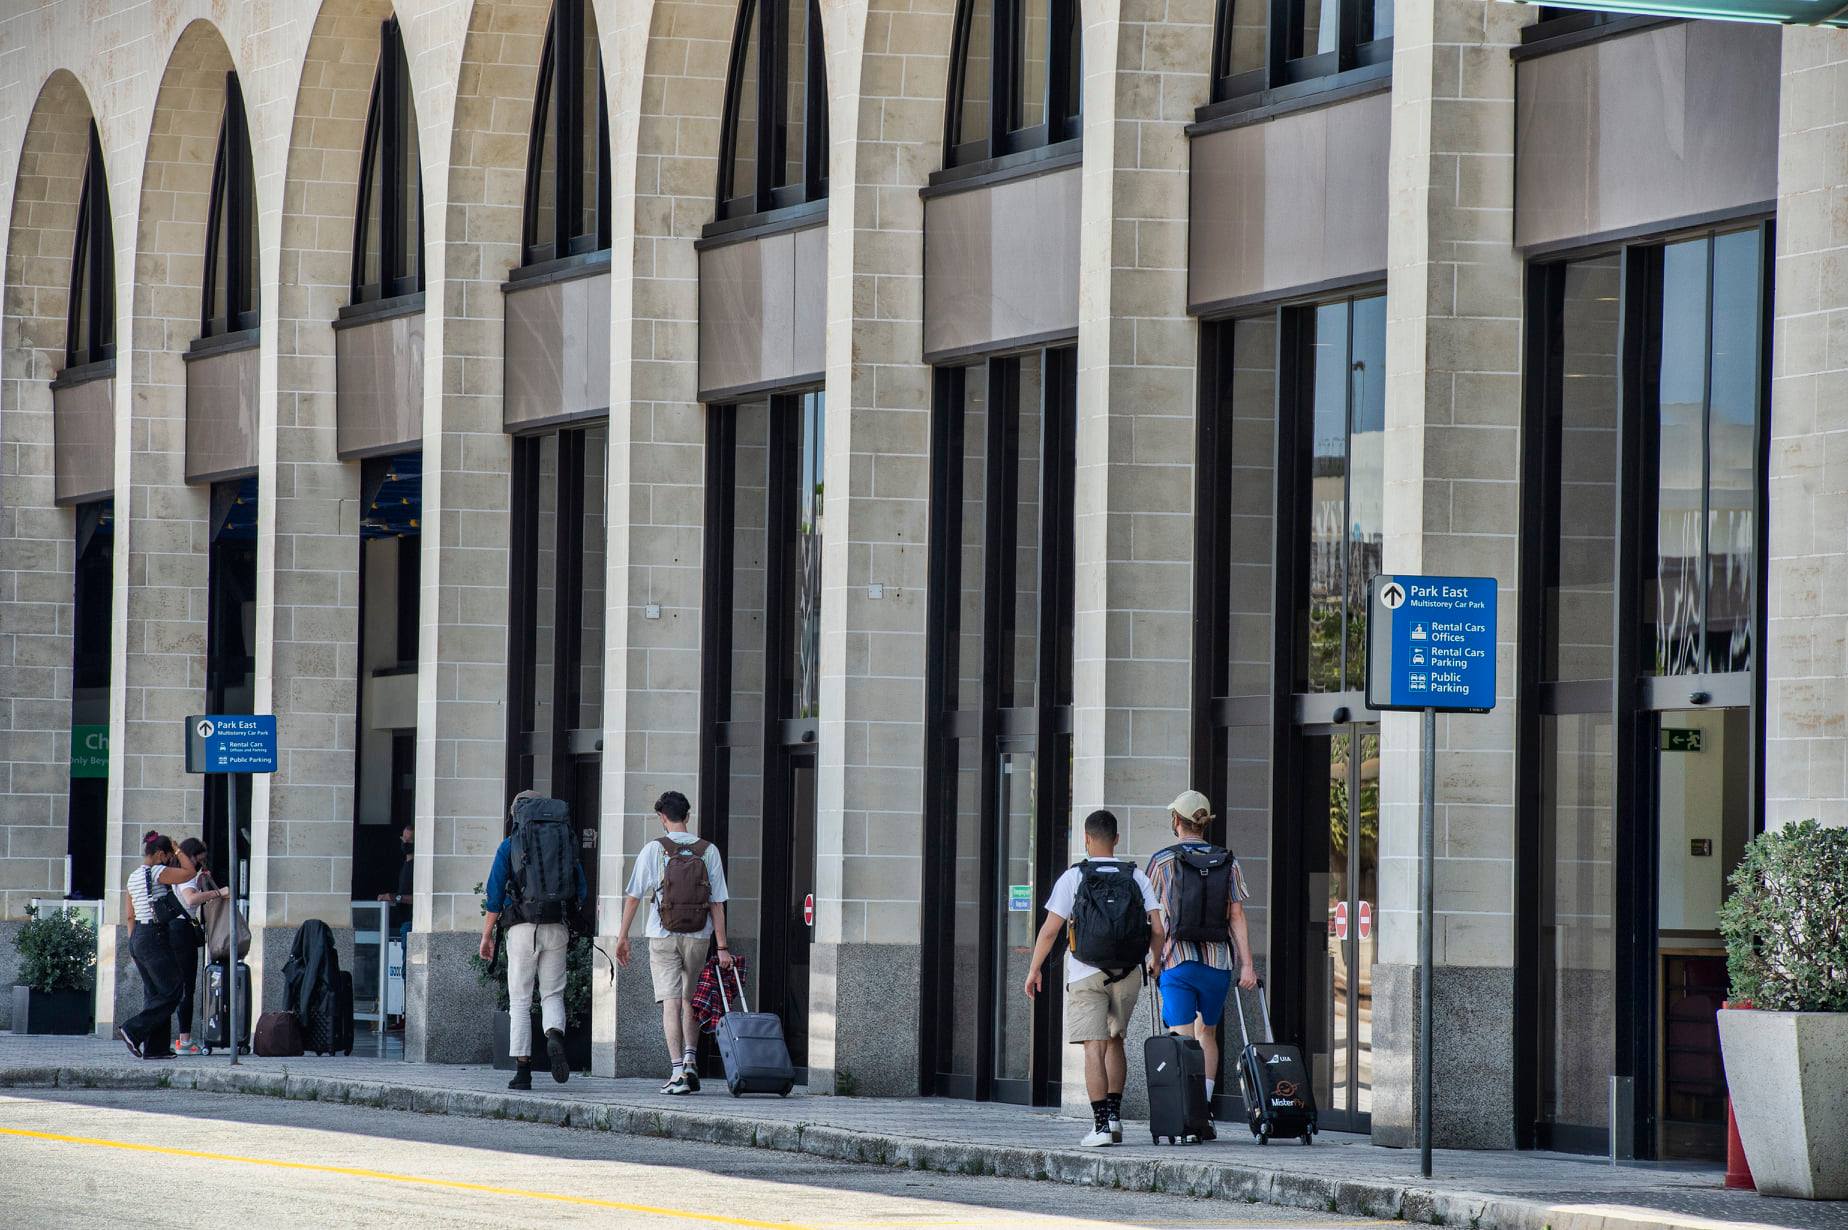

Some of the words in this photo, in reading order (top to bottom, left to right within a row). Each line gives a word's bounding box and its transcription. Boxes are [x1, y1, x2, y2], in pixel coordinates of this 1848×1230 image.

[1410, 585, 1438, 597] Park
[1442, 586, 1469, 598] East
[1410, 599, 1453, 610] Multistorey
[1454, 600, 1467, 608] Car
[1468, 601, 1485, 609] Park
[1431, 621, 1462, 632] Rental
[1465, 622, 1486, 633] Cars
[1431, 632, 1465, 642] Offices
[1431, 646, 1462, 657] Rental
[1464, 647, 1485, 658] Cars
[1431, 657, 1468, 670] Parking
[1431, 671, 1462, 682] Public
[1431, 682, 1470, 696] Parking
[217, 721, 237, 729] Park
[238, 721, 257, 729] East
